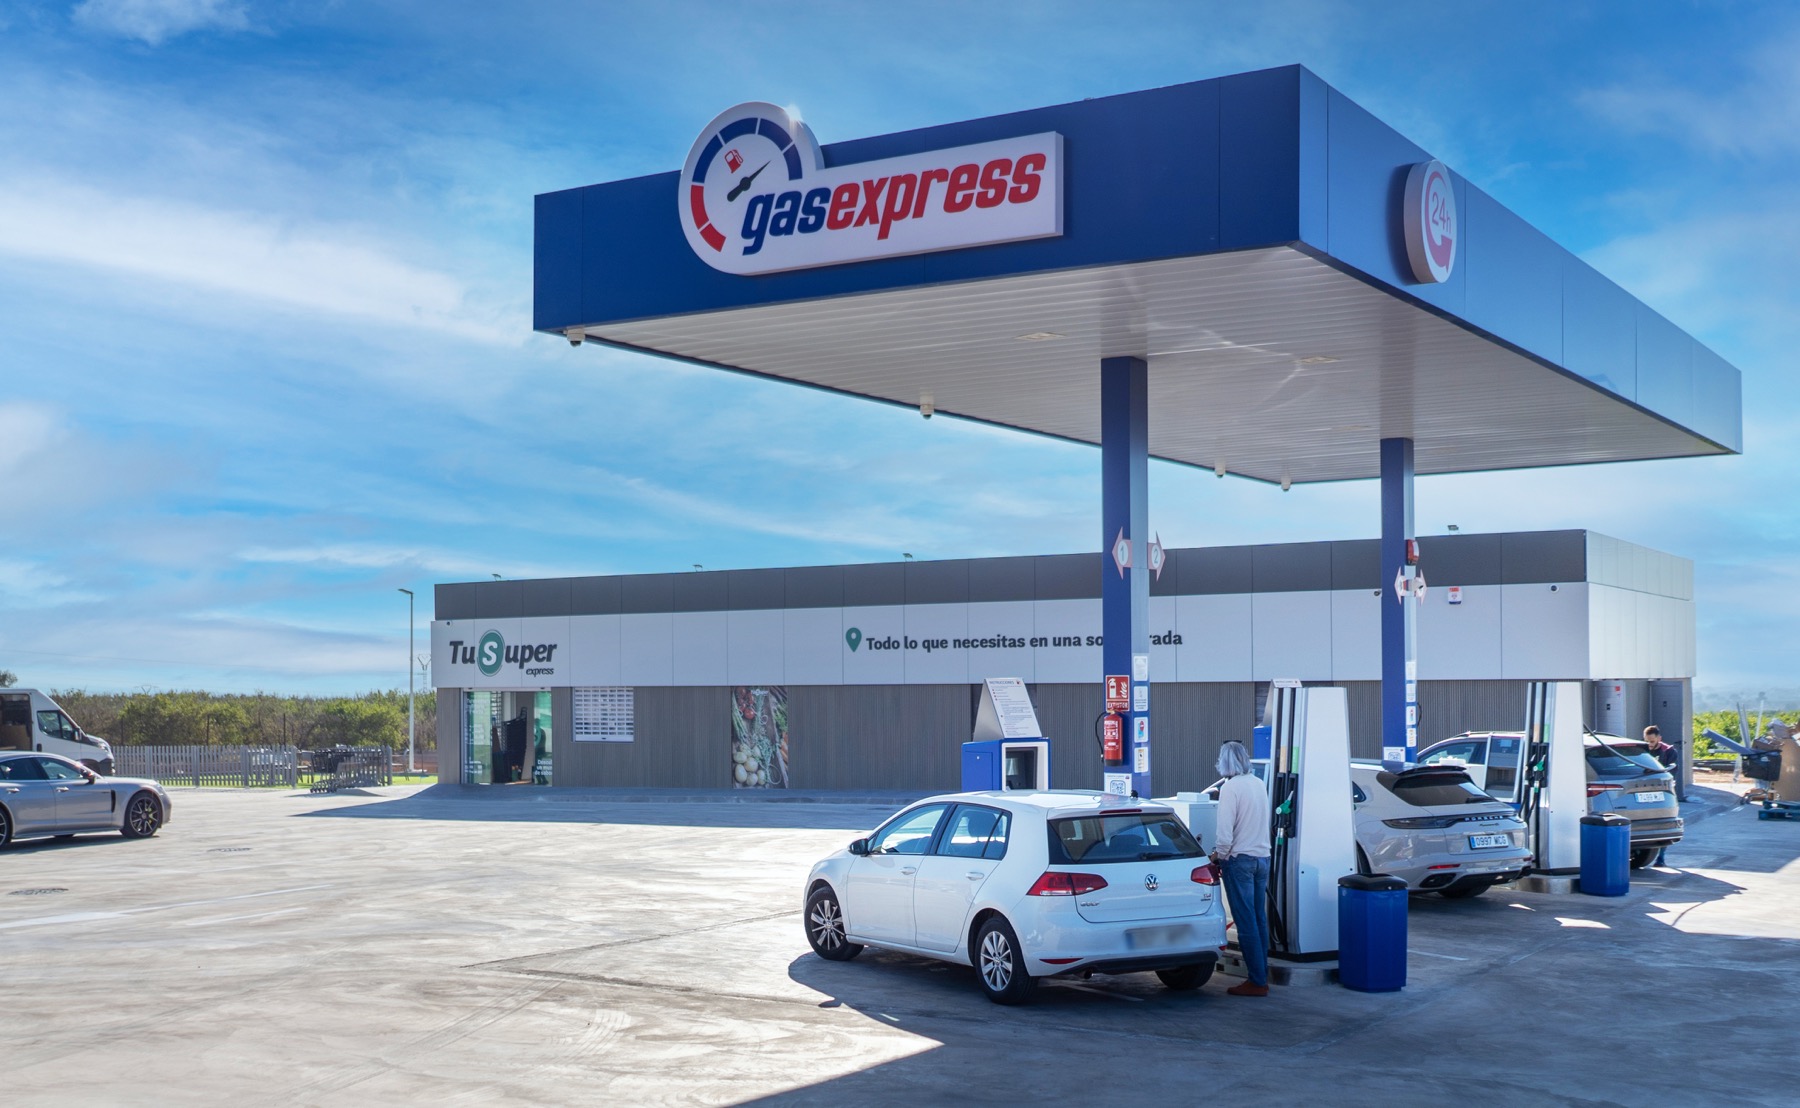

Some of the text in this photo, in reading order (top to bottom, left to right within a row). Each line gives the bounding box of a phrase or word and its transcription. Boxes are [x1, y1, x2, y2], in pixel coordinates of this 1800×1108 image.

[741, 153, 1046, 256] gasexpress
[1432, 191, 1452, 235] 24h
[866, 636, 900, 650] Todo
[904, 636, 918, 649] lo
[922, 638, 948, 653] que
[953, 634, 1025, 649] necesitas
[1029, 636, 1048, 647] en
[1052, 636, 1082, 647] una
[1086, 636, 1103, 646] so
[526, 667, 554, 677] express
